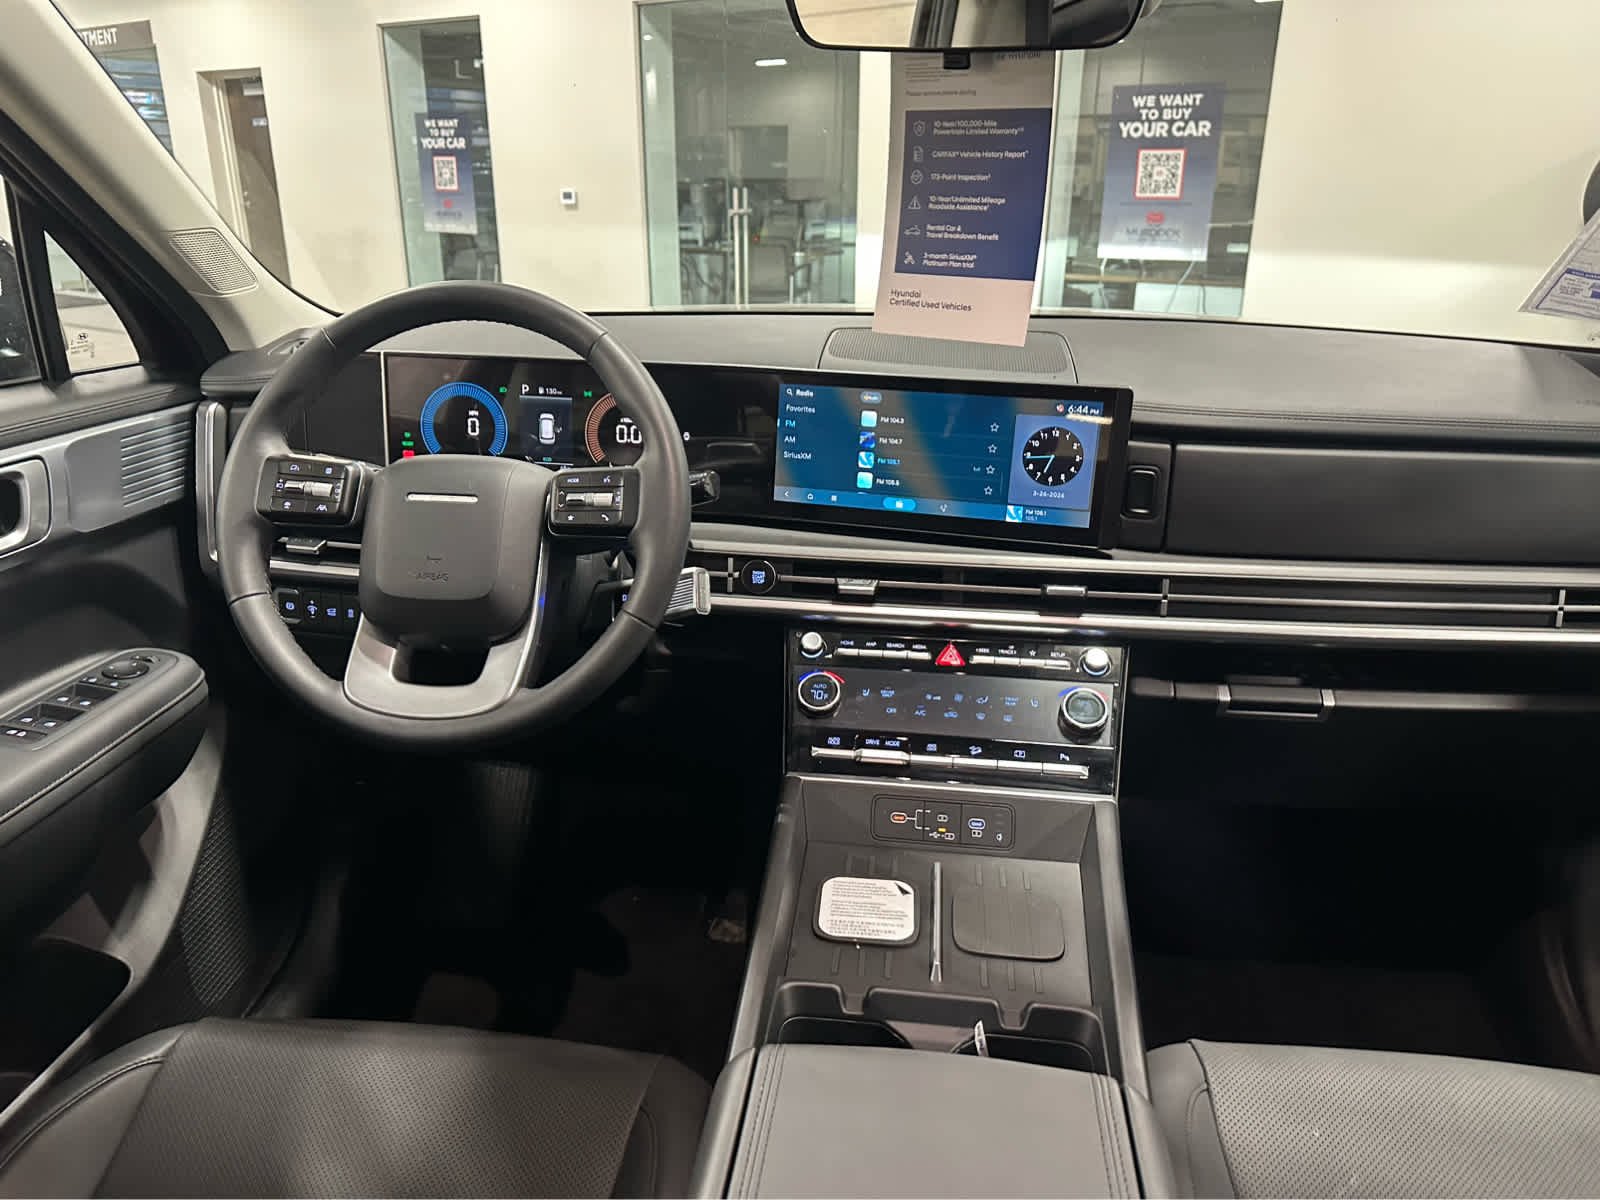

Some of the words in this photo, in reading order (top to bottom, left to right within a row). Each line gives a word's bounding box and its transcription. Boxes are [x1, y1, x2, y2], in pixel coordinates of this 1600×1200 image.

[1132, 95, 1156, 107] WE
[1159, 93, 1203, 107] WANT
[1139, 108, 1159, 120] TO
[1162, 108, 1193, 120] BUY
[424, 119, 436, 128] WE
[437, 118, 459, 128] WANT
[430, 128, 440, 137] TO
[440, 128, 455, 137] BUY
[1119, 121, 1168, 138] YOUR
[1171, 120, 1212, 137] CAR
[421, 137, 446, 149] YOUR
[446, 137, 466, 149] CAR
[890, 289, 922, 298] Hyundai
[889, 298, 919, 308] Certified
[921, 299, 940, 308] Used
[941, 301, 972, 311] Vehicles
[522, 384, 530, 395] P
[785, 404, 816, 413] Favorites
[1067, 405, 1089, 414] 6:44
[467, 418, 480, 436] 0
[1052, 429, 1060, 437] 12
[783, 451, 812, 460] SiriusXM
